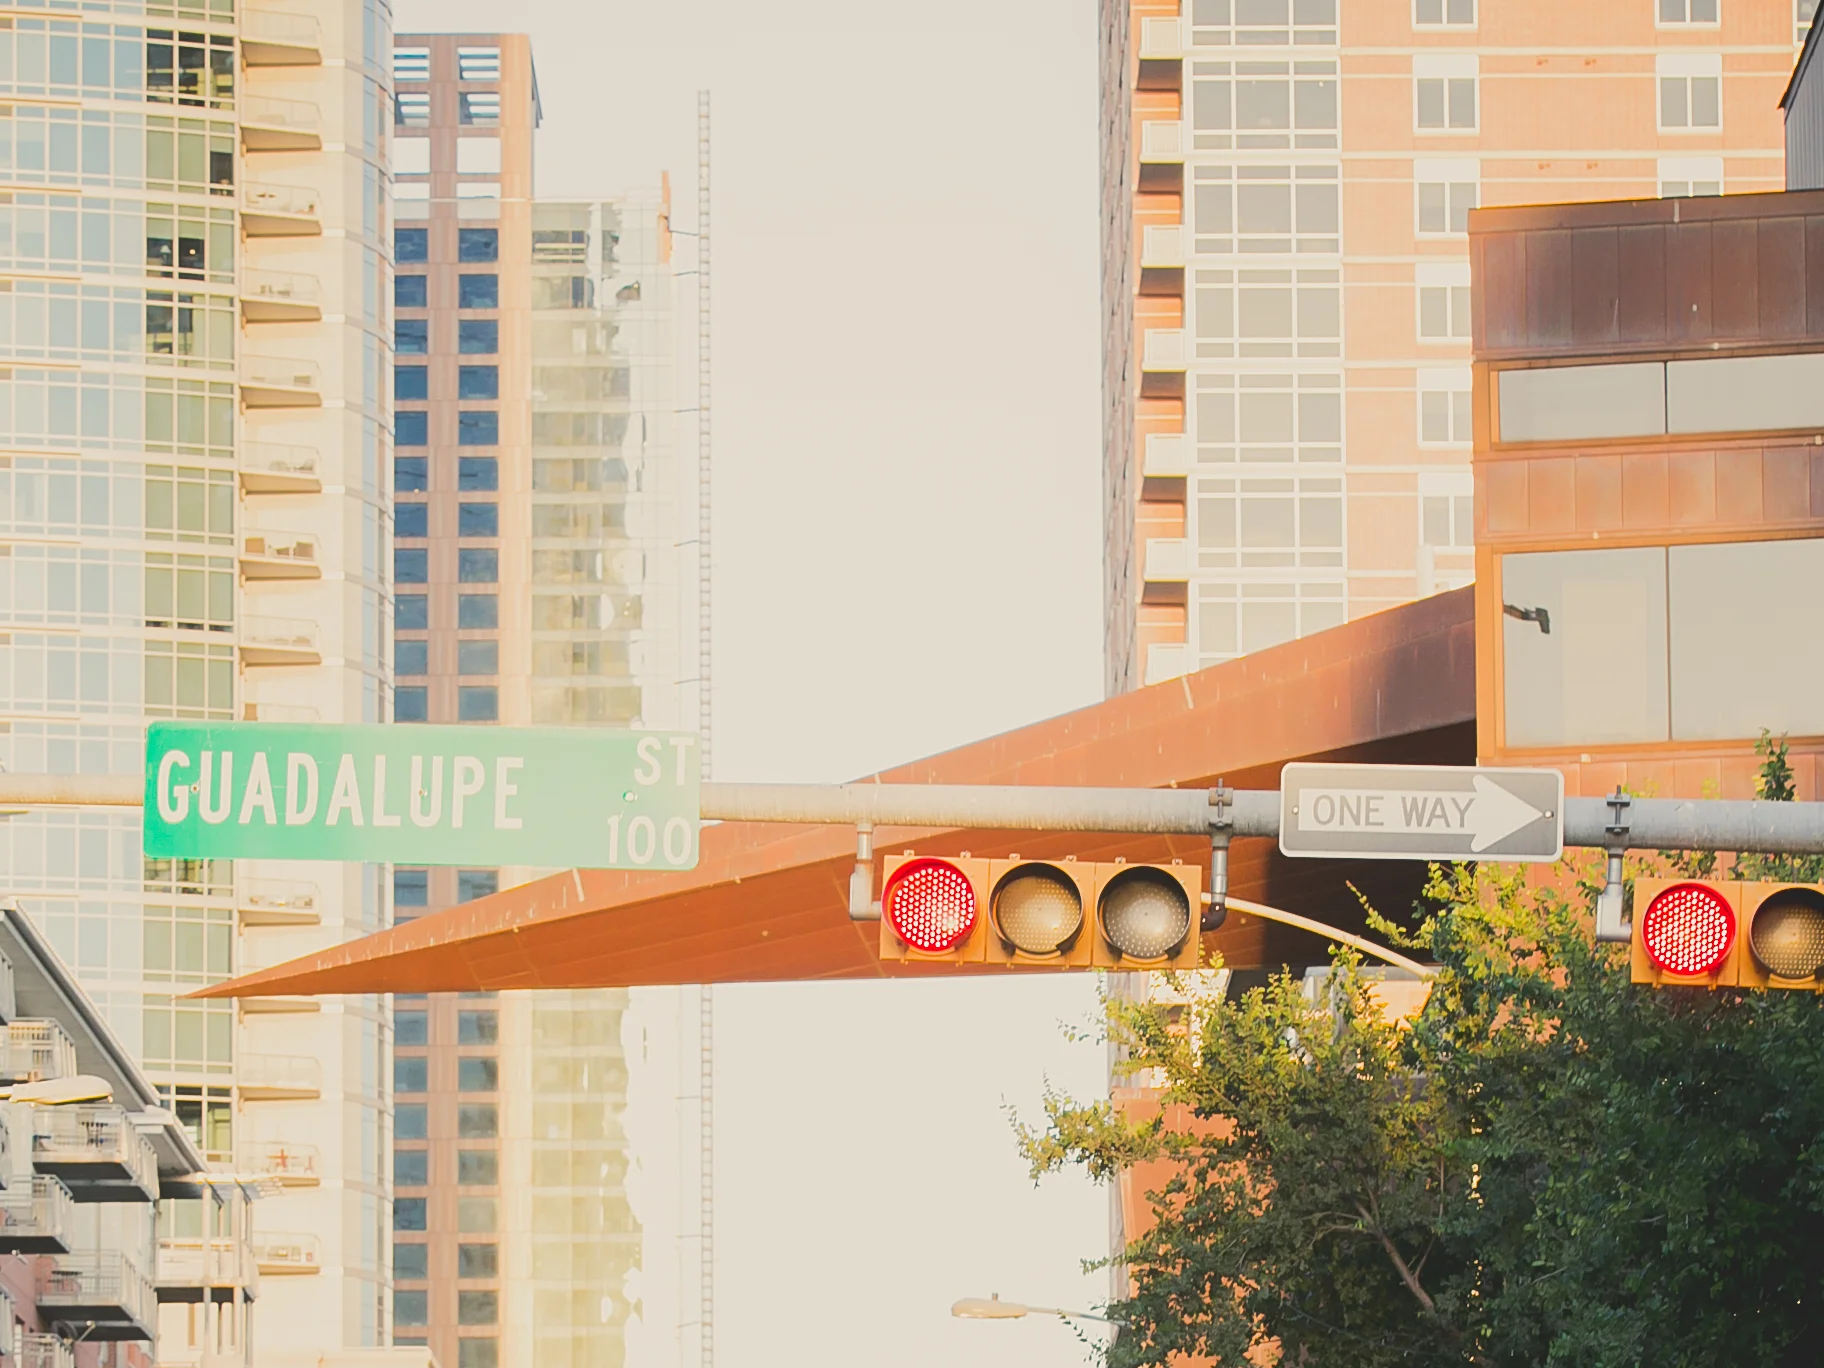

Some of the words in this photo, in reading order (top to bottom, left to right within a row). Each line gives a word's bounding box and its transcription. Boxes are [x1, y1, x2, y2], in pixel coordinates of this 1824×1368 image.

[157, 749, 524, 829] GUADALUPE
[634, 736, 696, 787] ST
[1312, 794, 1385, 827] ONE
[1401, 795, 1476, 829] WAY
[606, 814, 693, 866] 100
